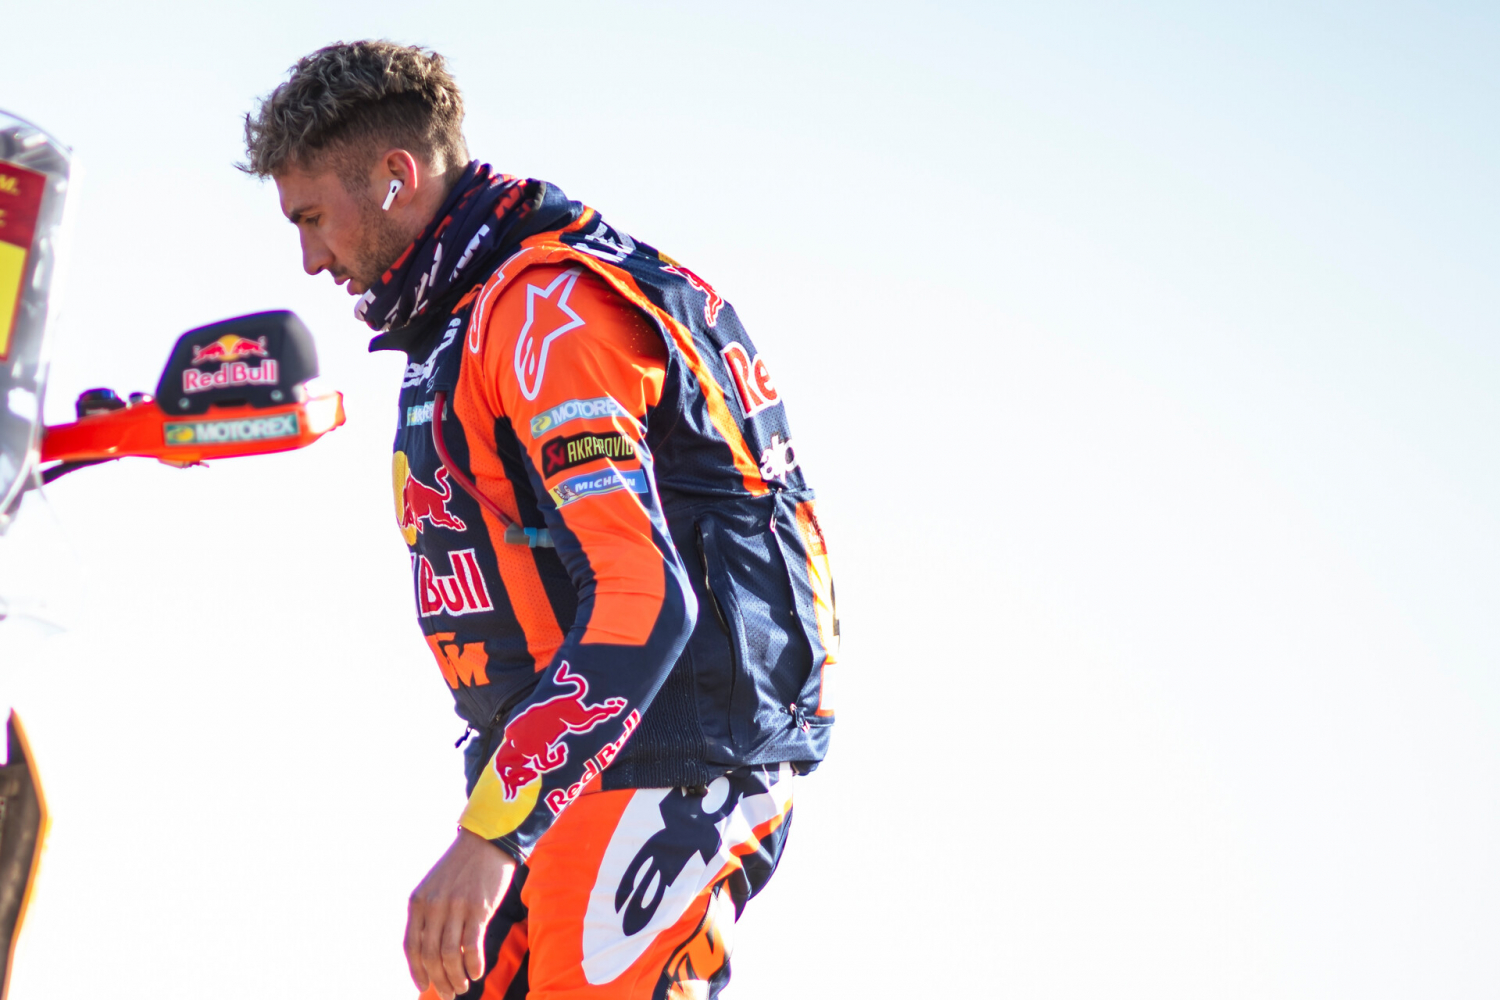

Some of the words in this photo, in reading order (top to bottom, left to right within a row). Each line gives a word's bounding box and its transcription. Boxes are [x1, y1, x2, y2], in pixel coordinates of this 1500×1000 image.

[182, 361, 230, 394] Red
[230, 359, 278, 387] Bull
[719, 341, 782, 419] Re
[551, 397, 622, 425] MOTORE
[195, 416, 296, 442] MOTOREX
[575, 474, 636, 493] MICHEN
[418, 547, 495, 617] Bull
[544, 758, 600, 817] Red
